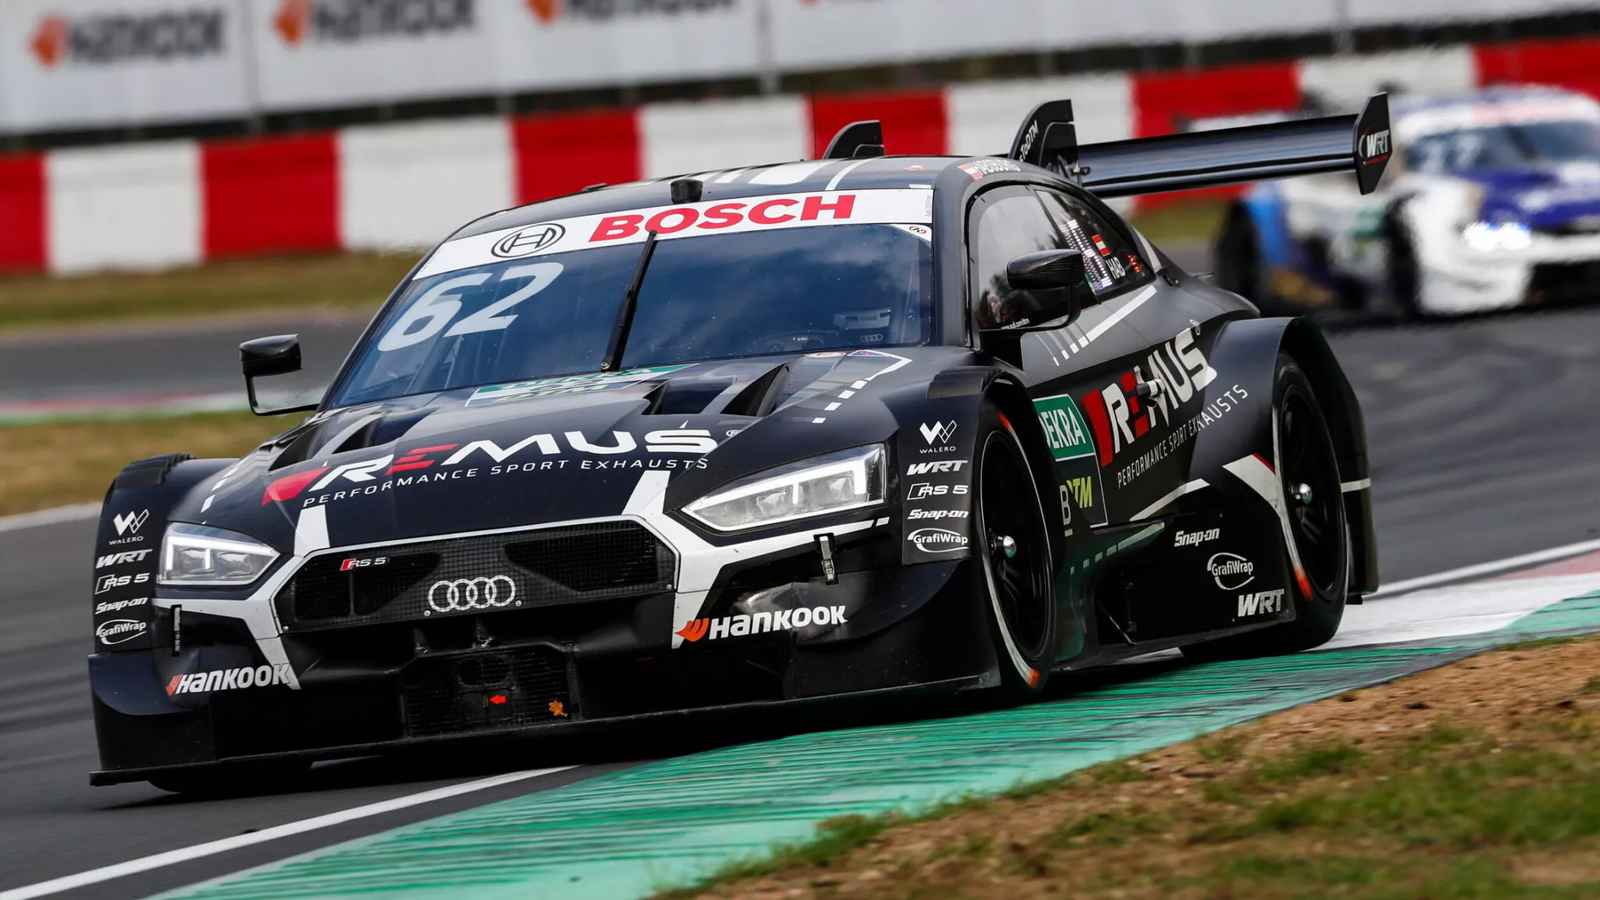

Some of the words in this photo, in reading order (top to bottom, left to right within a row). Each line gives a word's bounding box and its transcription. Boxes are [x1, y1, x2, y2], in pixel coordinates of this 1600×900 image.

[1366, 130, 1389, 157] WRT
[588, 194, 856, 243] BOSCH
[377, 261, 564, 352] 62
[1038, 406, 1086, 449] EKRA
[919, 445, 957, 455] WALERO
[308, 429, 718, 492] REMUS
[906, 459, 969, 476] WRT
[1117, 439, 1168, 489] PERFORMANCE
[302, 467, 480, 508] PERFORMANCE
[490, 459, 570, 475] SPORT
[580, 457, 709, 470] EXHAUSTS
[907, 508, 969, 520] Snap-on
[108, 535, 144, 546] WALERO
[913, 532, 969, 546] GrafiWrap
[1174, 528, 1220, 547] Snap-on
[95, 548, 153, 569] WRT
[1211, 559, 1254, 577] GrafiWrap
[95, 597, 148, 614] Snap-on
[1237, 588, 1285, 617] WRT
[100, 621, 147, 639] GrafiWrap
